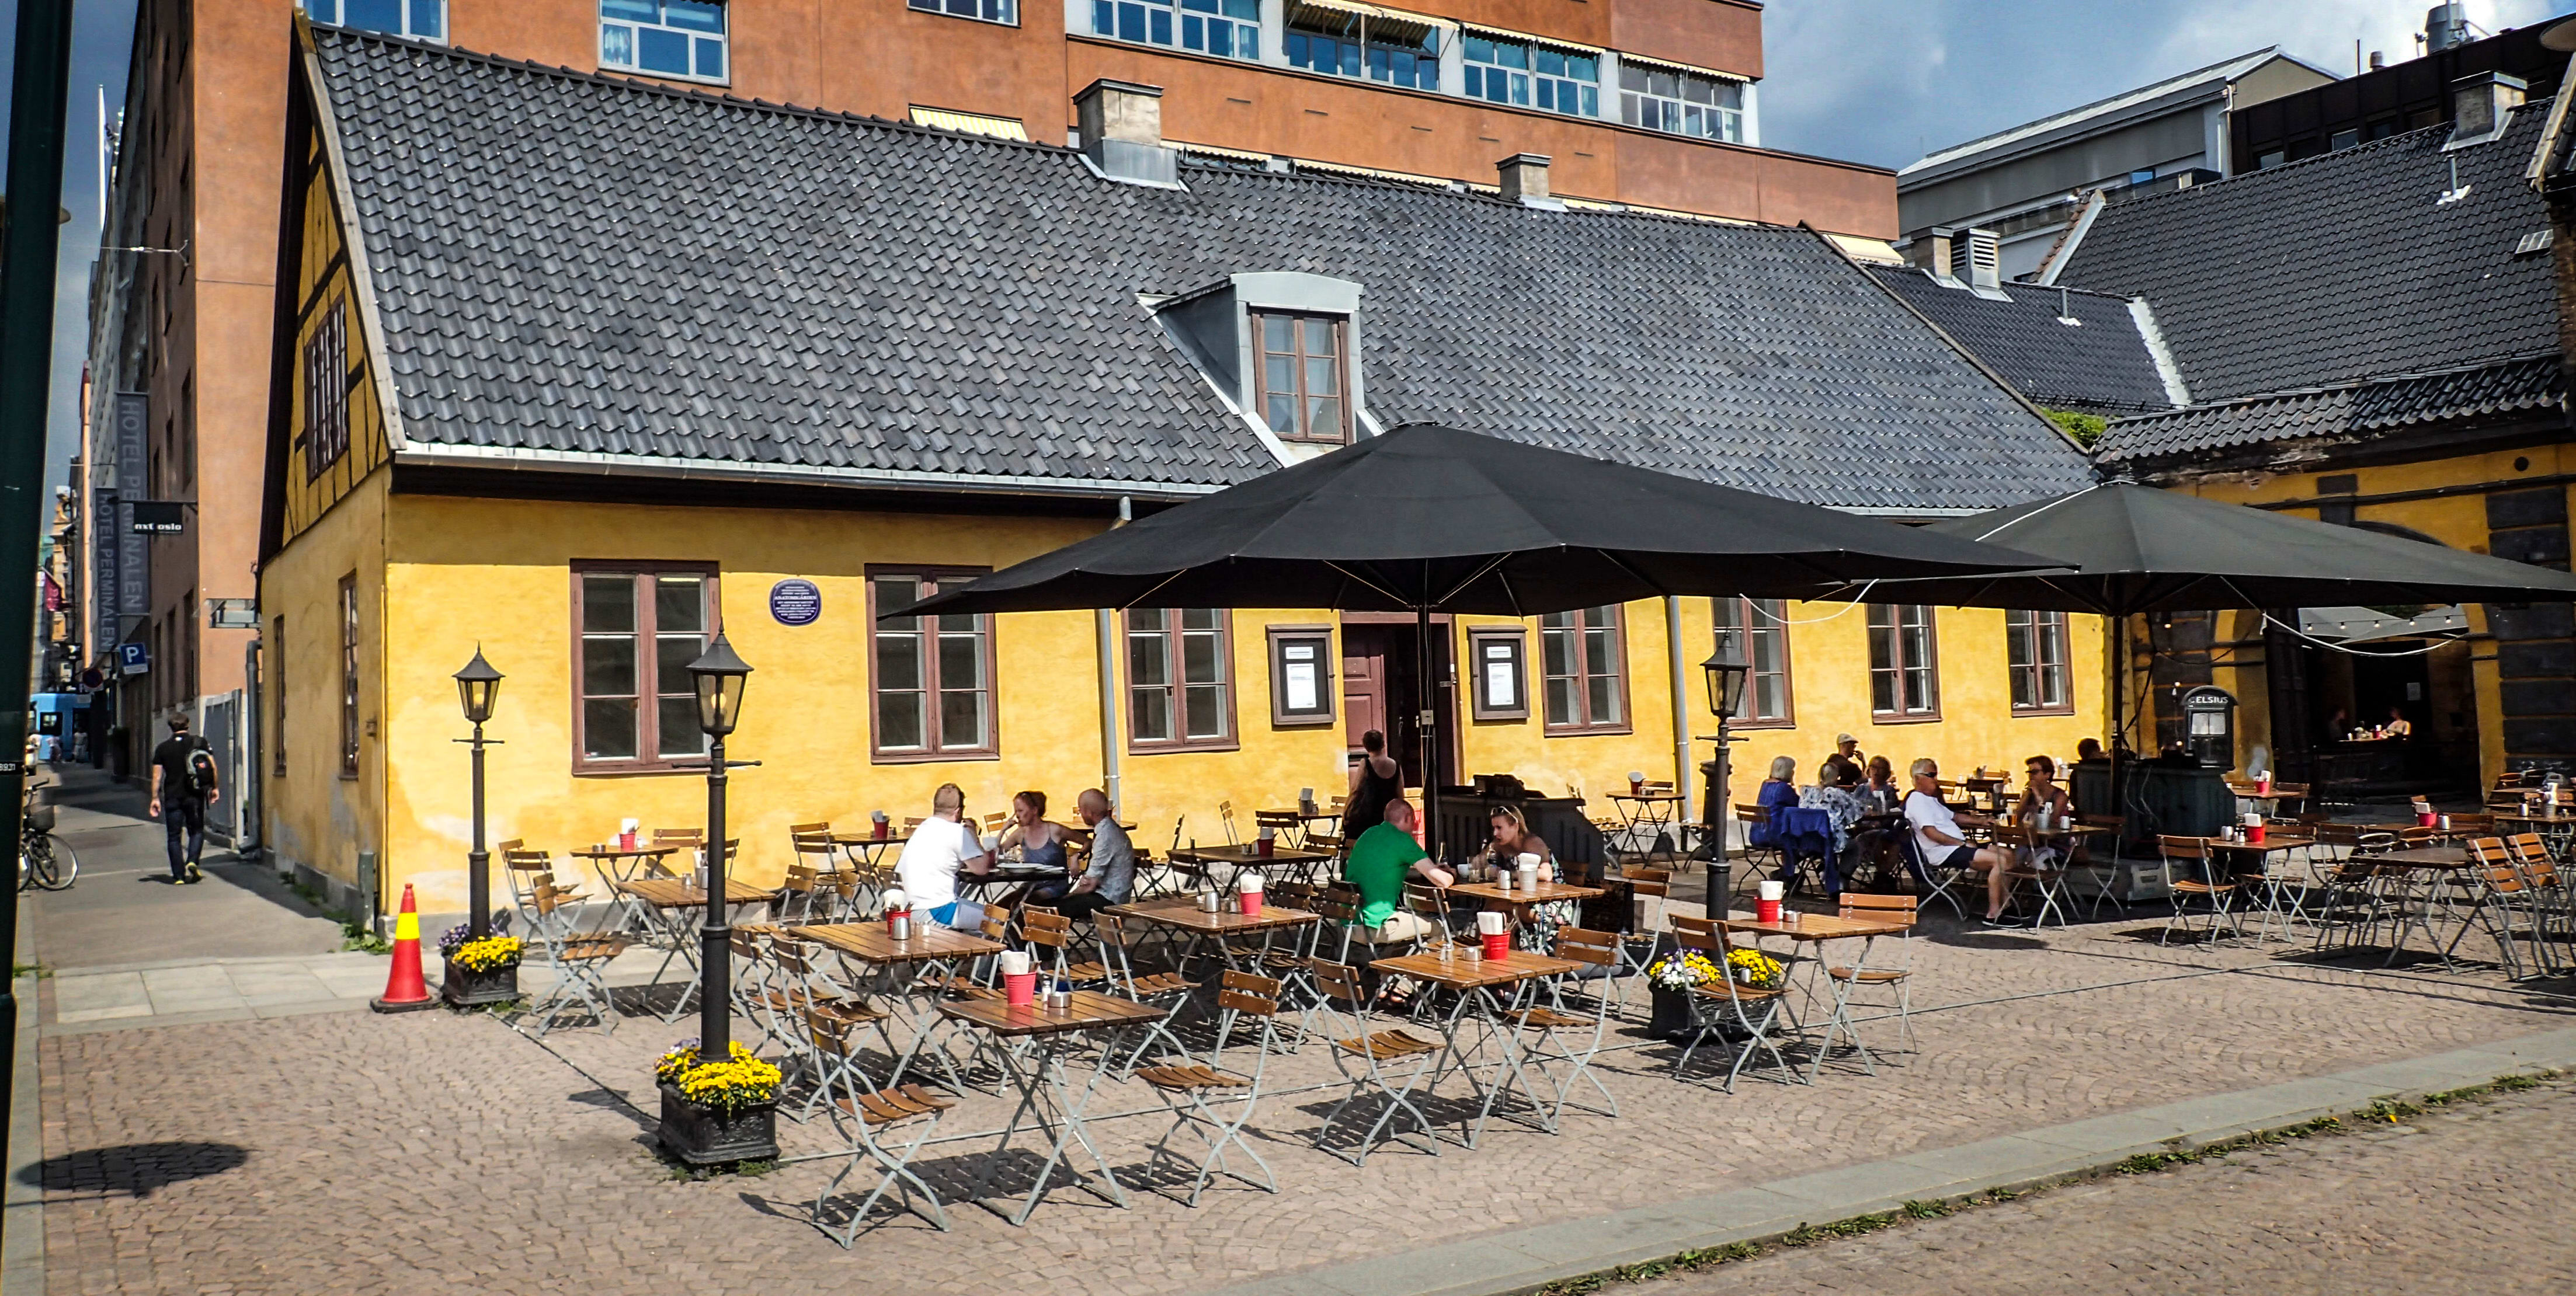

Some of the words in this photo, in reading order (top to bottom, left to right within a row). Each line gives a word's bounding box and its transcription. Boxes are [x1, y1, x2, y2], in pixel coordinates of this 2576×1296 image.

[121, 402, 140, 469] HOTEL
[98, 493, 114, 544] HOTEL
[100, 549, 115, 647] PERMINALEN
[126, 646, 139, 663] P
